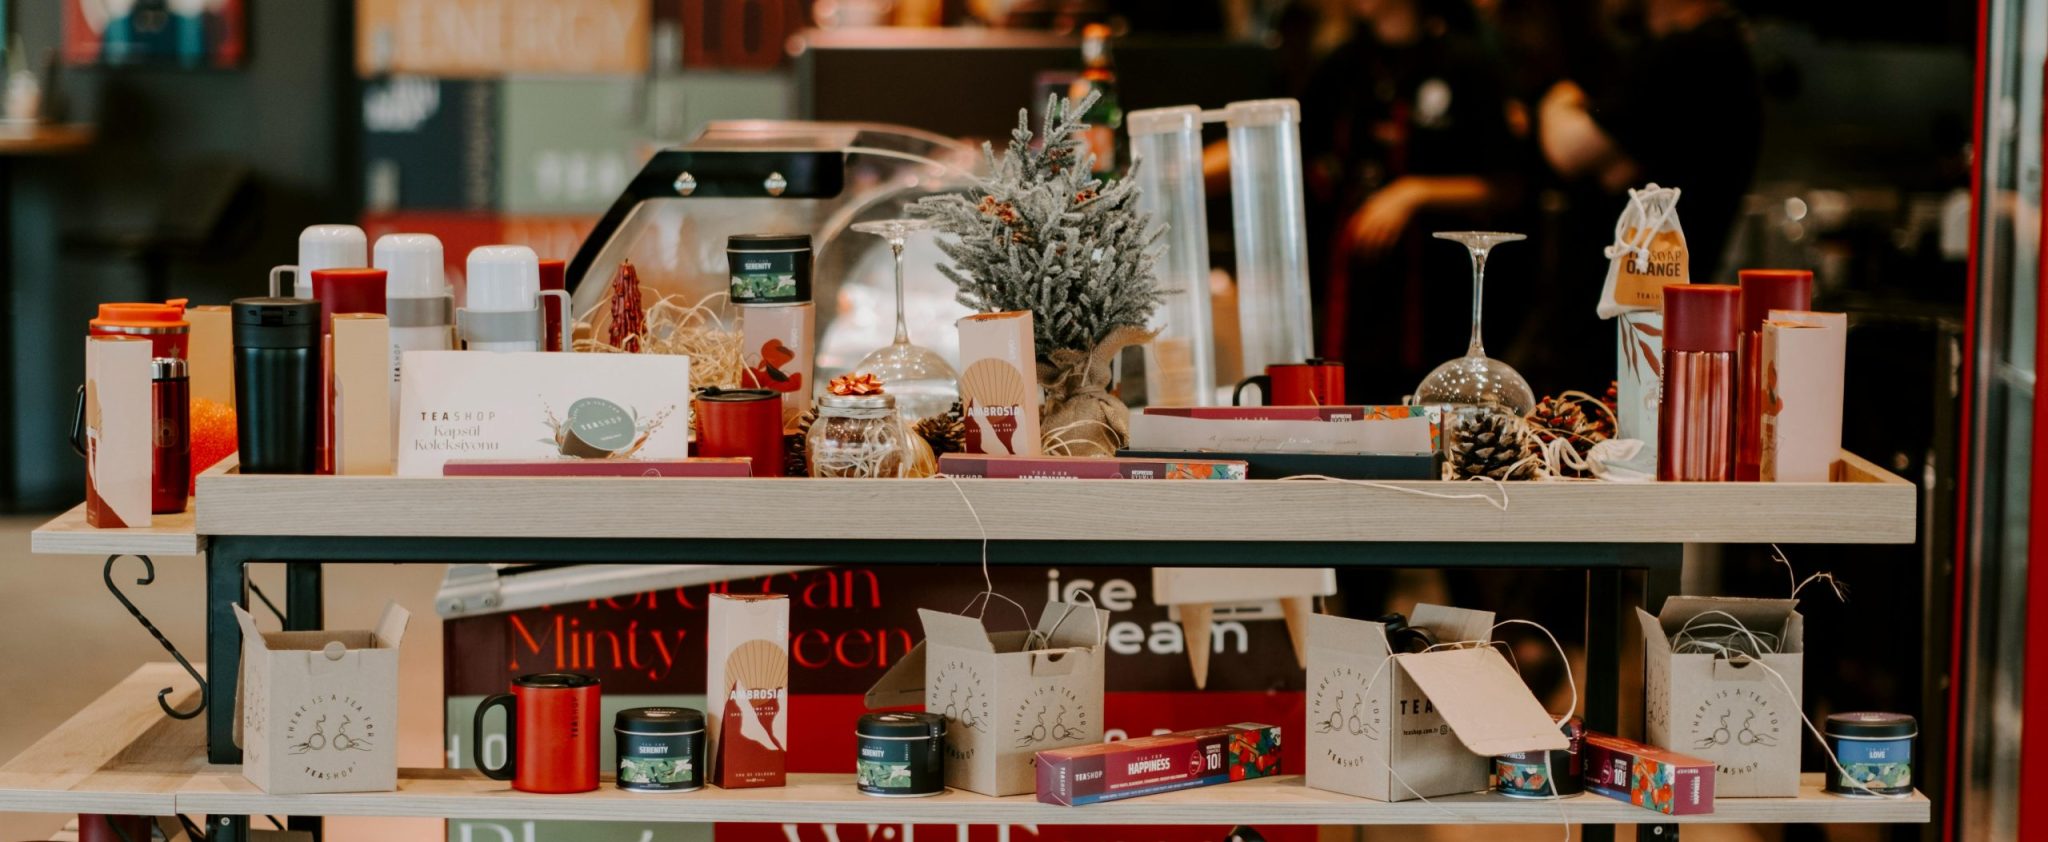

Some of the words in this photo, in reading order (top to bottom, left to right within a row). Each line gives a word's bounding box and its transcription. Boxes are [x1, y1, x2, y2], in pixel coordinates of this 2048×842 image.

[421, 412, 496, 421] TEASHOP
[968, 406, 1021, 417] AMBROSIA
[434, 425, 480, 439] Kapsül
[415, 439, 500, 452] Koleksiyonu
[1047, 568, 1137, 612] ice
[1107, 620, 1249, 655] eam
[510, 614, 686, 681] Minty
[730, 689, 783, 701] AMBROSIA
[639, 746, 669, 754] SERENITY
[862, 748, 885, 758] SERENITY
[1869, 751, 1886, 759] LOVE
[1128, 758, 1171, 776] HAPPINESS
[1206, 753, 1218, 771] 10
[305, 766, 353, 780] TEASHOP
[1716, 762, 1758, 776] EASHOP
[1075, 770, 1103, 782] TEASHOP
